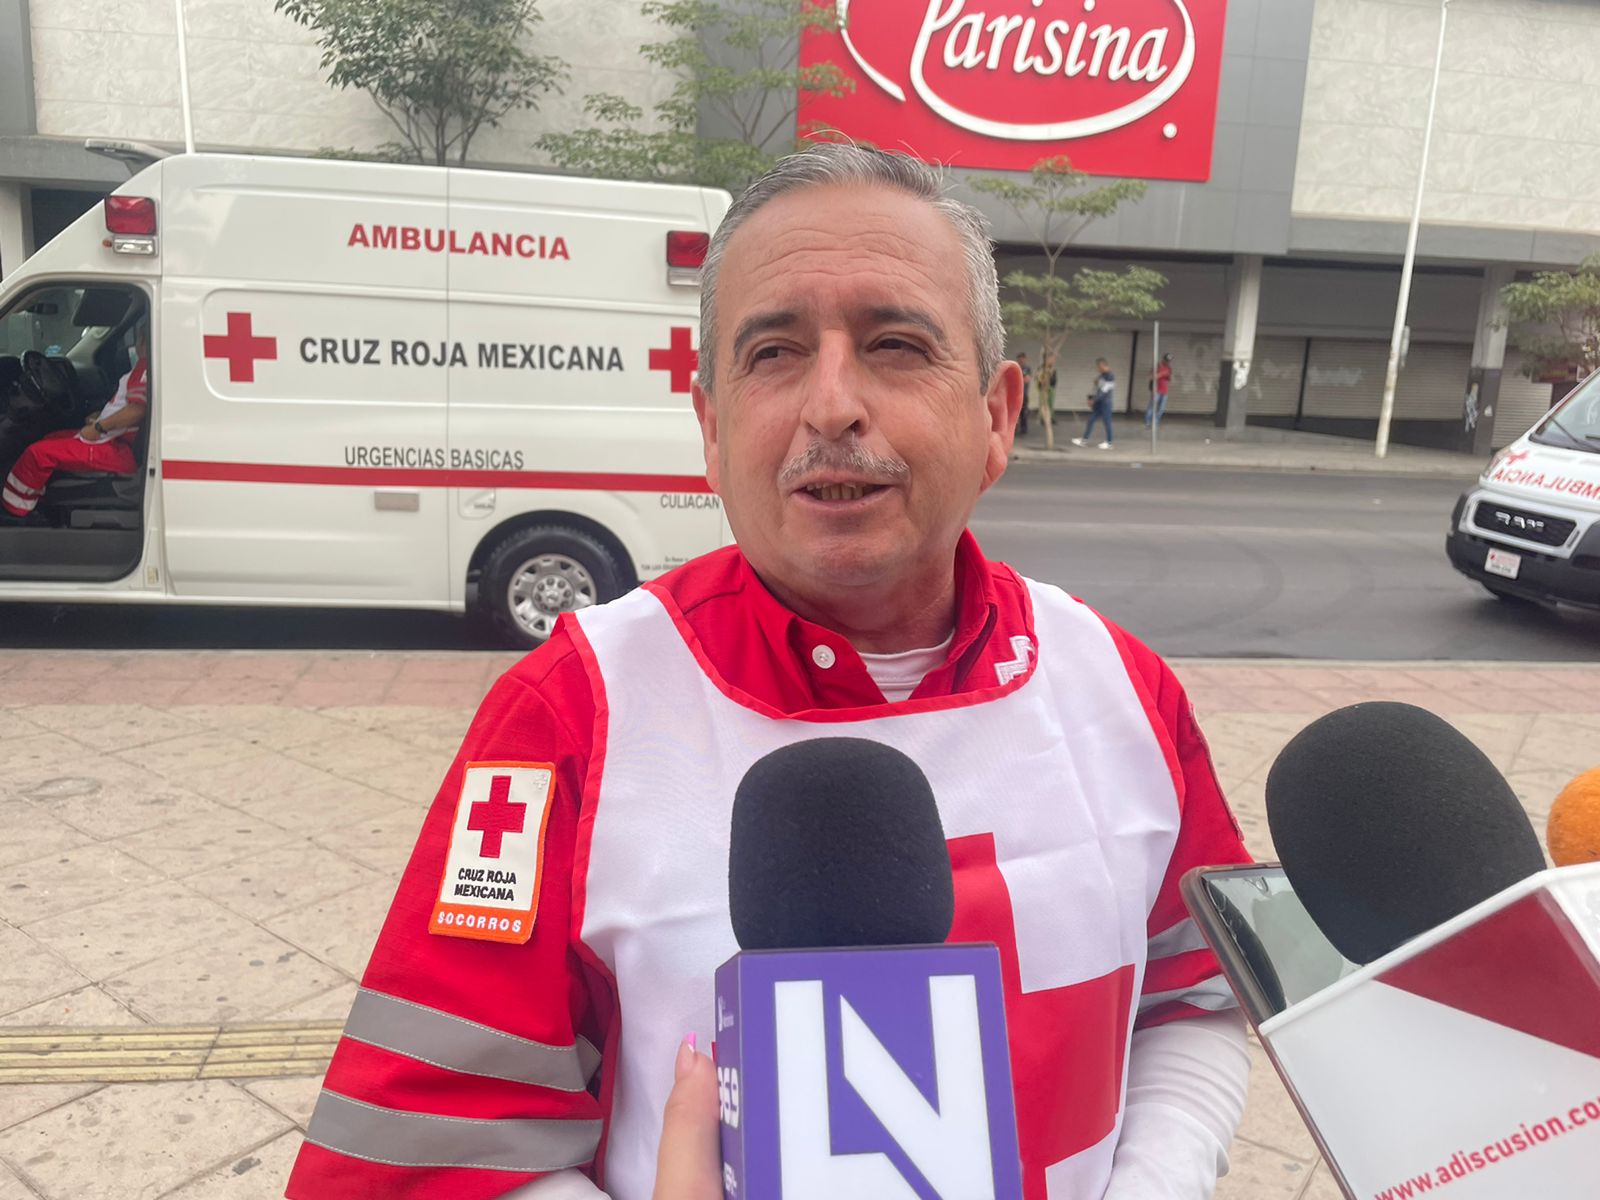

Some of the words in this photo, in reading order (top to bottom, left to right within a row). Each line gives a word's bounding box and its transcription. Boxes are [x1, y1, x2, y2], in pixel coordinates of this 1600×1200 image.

[910, 0, 1170, 83] Parisina
[347, 223, 570, 260] AMBULANCIA
[299, 336, 381, 366] CRUZ
[390, 340, 469, 369] ROJA
[477, 342, 625, 373] MEXICANA
[344, 445, 446, 469] URGENCIAS
[450, 448, 525, 472] BASICAS
[660, 494, 720, 510] CULIACAN
[458, 867, 484, 882] CRUZ
[486, 870, 516, 884] ROJA
[454, 884, 514, 901] MEXICANA
[437, 911, 522, 932] SOCORROS
[1373, 1095, 1600, 1200] www.adiscusion.co
